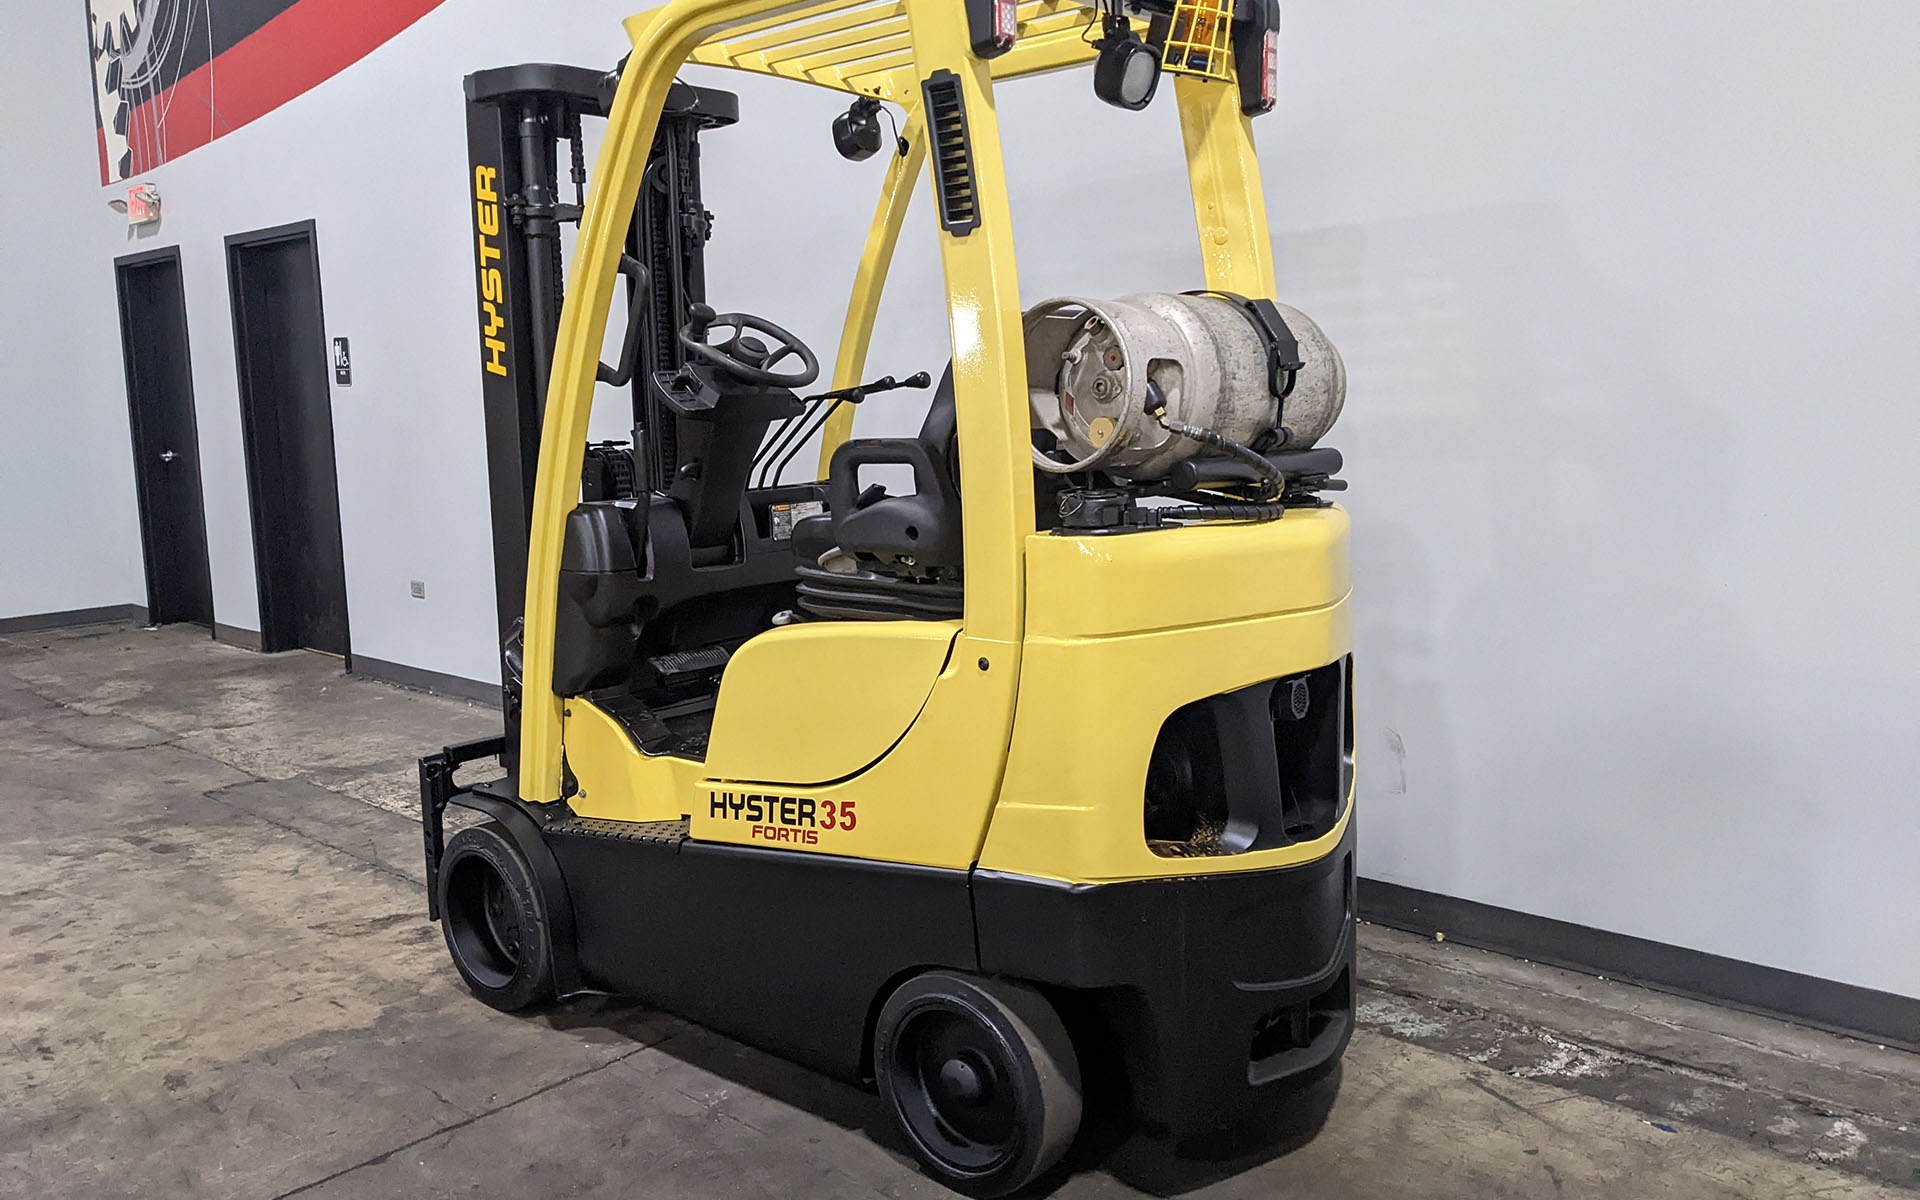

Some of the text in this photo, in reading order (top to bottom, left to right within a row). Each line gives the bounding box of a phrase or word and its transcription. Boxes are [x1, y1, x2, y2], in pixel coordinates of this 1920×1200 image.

[475, 165, 507, 377] HYSTER
[710, 791, 857, 831] HYSTER 35
[751, 825, 819, 845] FORTIS
